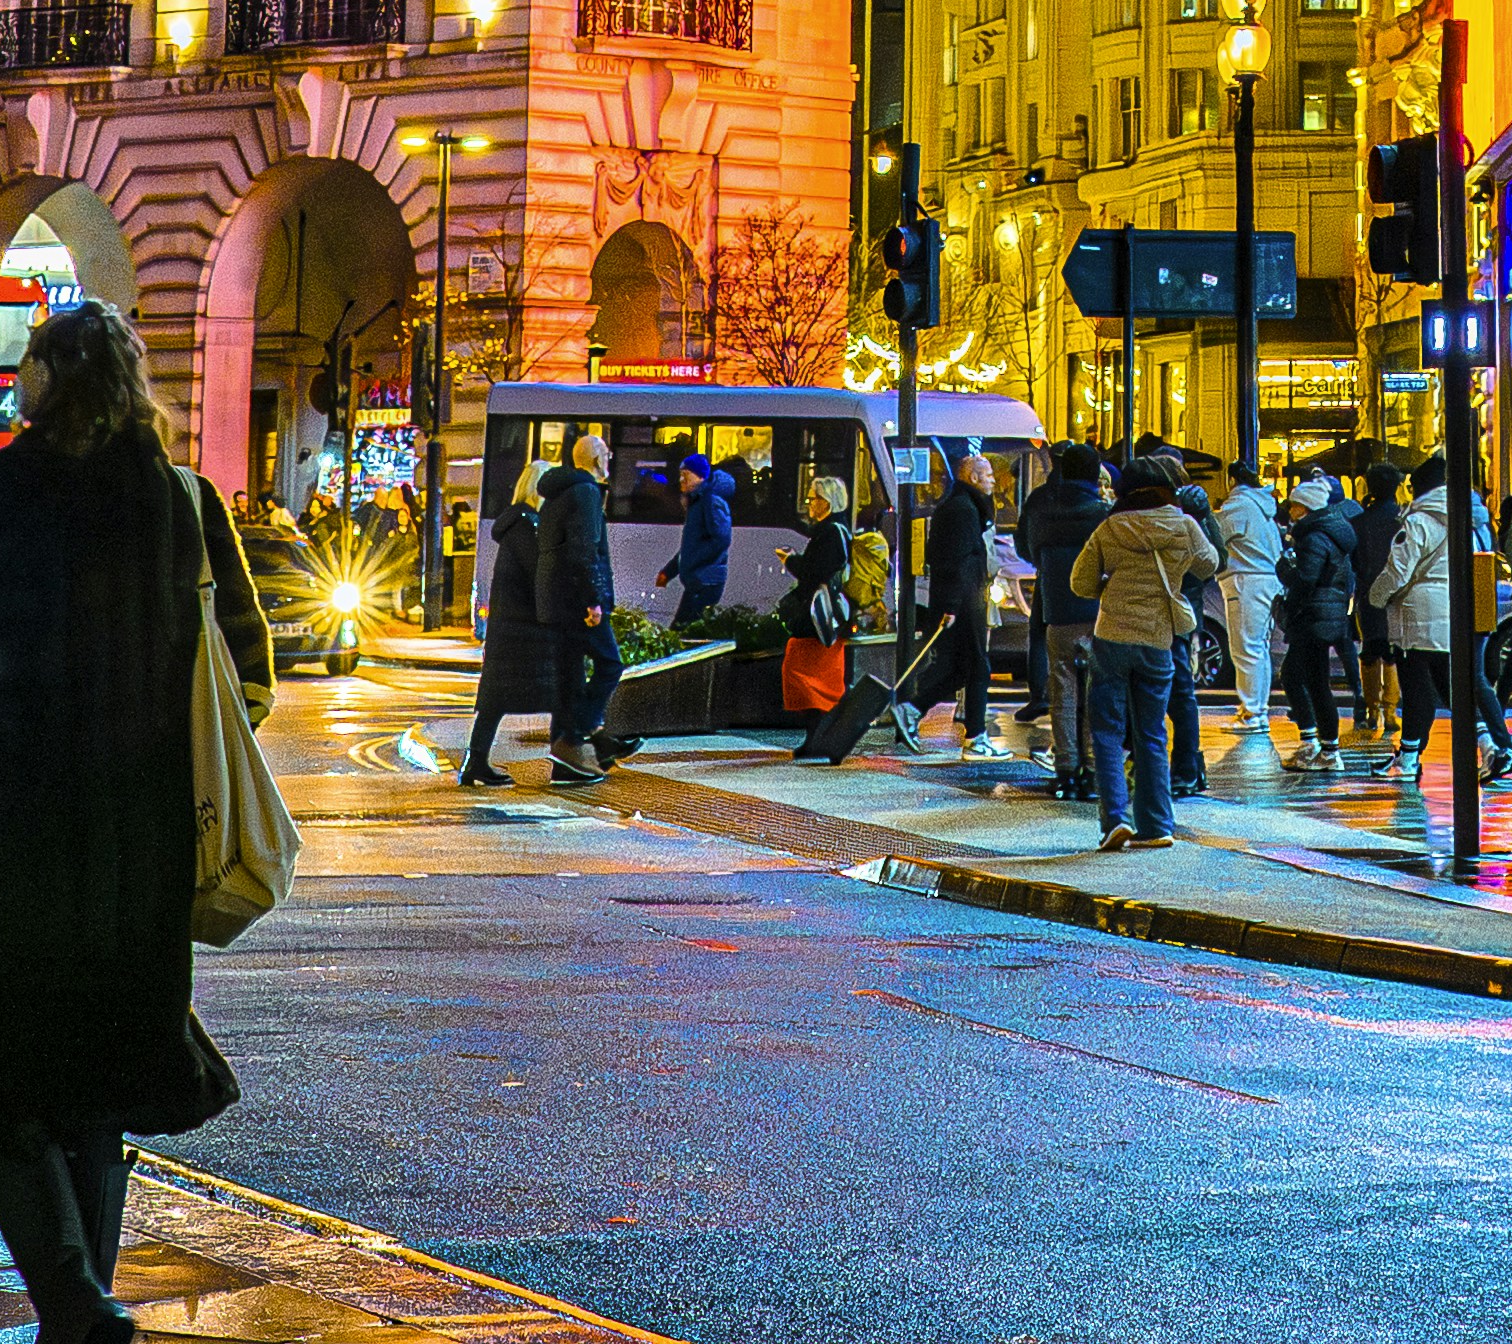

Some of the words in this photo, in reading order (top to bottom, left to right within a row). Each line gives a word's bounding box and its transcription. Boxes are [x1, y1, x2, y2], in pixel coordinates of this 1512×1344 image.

[599, 365, 623, 377] BUY
[623, 365, 670, 377] TICKETS
[670, 365, 700, 377] HERE
